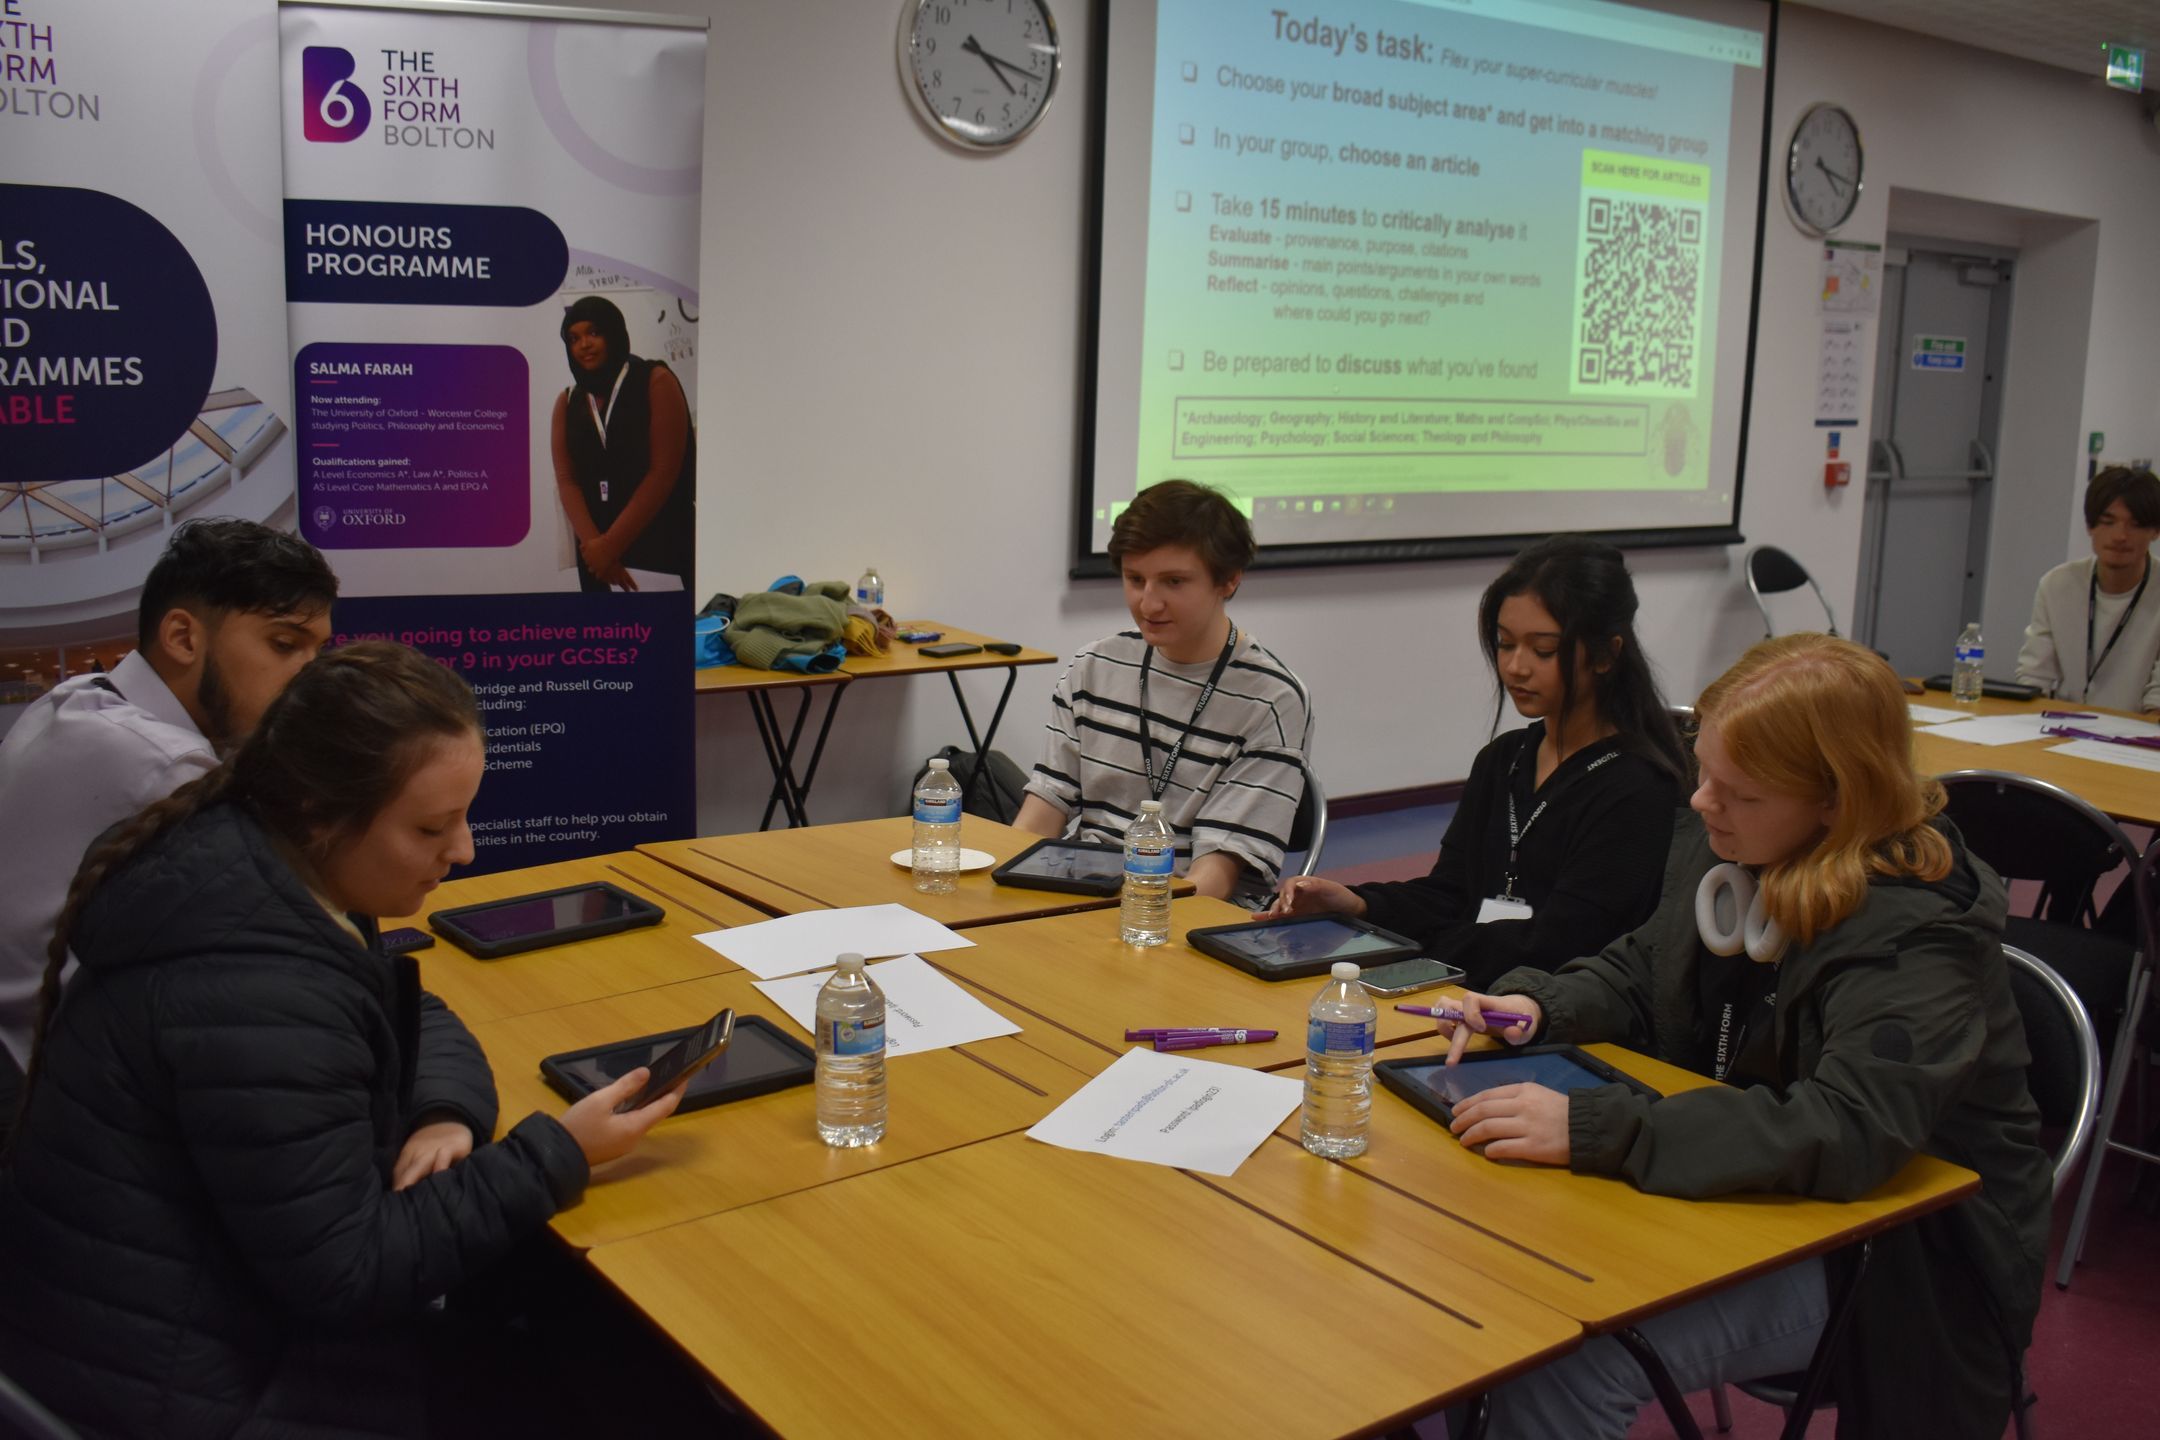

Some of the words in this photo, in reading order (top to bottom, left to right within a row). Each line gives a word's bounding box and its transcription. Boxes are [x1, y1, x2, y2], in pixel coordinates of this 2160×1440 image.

[935, 5, 950, 25] 10
[1023, 20, 1033, 38] 2
[926, 38, 936, 56] 9
[381, 49, 435, 73] THE
[1029, 53, 1038, 71] 3
[1376, 29, 1433, 64] task:
[1440, 47, 1469, 69] Flex
[1472, 54, 1503, 75] your
[1505, 61, 1604, 92] super-curricular
[383, 75, 458, 99] SIXTH
[932, 70, 942, 88] 8
[1019, 83, 1028, 100] 4
[384, 100, 460, 124] FORM
[952, 97, 962, 114] 7
[1002, 103, 1010, 121] 5
[1216, 64, 1285, 94] Choose
[1290, 79, 1328, 101] your
[1332, 81, 1383, 108] broad
[1387, 92, 1448, 119] subject
[1497, 108, 1525, 128] and
[1529, 113, 1553, 134] get
[1557, 117, 1585, 136] into
[1588, 125, 1597, 138] a
[1601, 123, 1665, 153] matching
[1667, 134, 1709, 157] group
[975, 107, 985, 125] 6
[384, 125, 494, 150] BOLTON
[1214, 126, 1231, 149] In
[1236, 133, 1275, 156] your
[1280, 138, 1333, 164] group,
[1339, 142, 1401, 168] choose
[1406, 153, 1427, 171] an
[1431, 154, 1480, 177] article
[1211, 192, 1254, 218] Take
[1260, 197, 1281, 220] 15
[1286, 200, 1357, 227] minutes
[1361, 208, 1378, 228] to
[1382, 210, 1452, 238] critically
[1455, 217, 1515, 242] analyse
[1518, 221, 1528, 241] it
[306, 223, 452, 250] HONOURS
[1209, 224, 1272, 245] Evaluate
[307, 252, 491, 279] PROGRAMME
[1208, 249, 1289, 271] Summarise
[1207, 274, 1259, 293] Reflect
[0, 279, 120, 311] IONAL
[1273, 305, 1314, 321] where
[1316, 306, 1351, 323] could
[1354, 310, 1377, 326] you
[310, 362, 361, 376] SALMA
[365, 363, 414, 376] FARAH
[1203, 350, 1227, 372] Be
[1232, 352, 1311, 378] prepared
[1315, 354, 1332, 374] to
[1336, 353, 1402, 375] discuss
[1406, 356, 1443, 376] what
[1498, 357, 1539, 380] found
[311, 395, 334, 405] Now
[334, 396, 381, 406] attending:
[312, 409, 329, 418] The
[331, 409, 374, 419] University
[376, 409, 386, 418] of
[387, 409, 418, 418] Oxford
[428, 410, 472, 419] Worcester
[474, 410, 508, 420] College
[1338, 411, 1376, 427] History
[311, 422, 349, 432] studying
[352, 422, 385, 431] Politics,
[387, 422, 435, 432] Philosophy
[438, 422, 454, 431] and
[457, 423, 504, 432] Economics
[312, 457, 376, 466] Qualifications
[378, 458, 411, 467] gained:
[313, 471, 320, 479] A
[321, 471, 345, 479] Level
[347, 471, 396, 479] Economics
[413, 471, 431, 479] Law
[448, 470, 478, 479] Politics
[327, 483, 350, 491] Level
[377, 483, 432, 491] Mathematics
[461, 484, 480, 492] EPQ
[342, 514, 406, 525] OXFORD
[401, 628, 462, 648] going
[469, 627, 492, 642] to
[497, 624, 577, 642] achieve
[582, 622, 652, 643] mainly
[463, 652, 476, 669] 9
[482, 650, 501, 668] in
[507, 653, 553, 672] your
[560, 648, 638, 666] GCSEs?
[519, 681, 543, 693] and
[546, 680, 590, 692] Russell
[593, 679, 633, 693] Group
[1195, 681, 1214, 712] STUDENT
[530, 722, 566, 736] (EPQ)
[1156, 780, 1165, 793] THE
[1161, 760, 1173, 780] SIXTH
[1169, 740, 1181, 761] FORM
[525, 815, 552, 828] staff
[555, 815, 568, 827] to
[572, 812, 599, 827] help
[602, 814, 625, 828] you
[629, 811, 668, 824] obtain
[1509, 813, 1517, 832] SIXTH
[510, 832, 522, 844] in
[526, 831, 546, 843] the
[549, 829, 600, 844] country.
[1720, 1003, 1732, 1032] FORM
[1717, 1034, 1727, 1062] SIXTH
